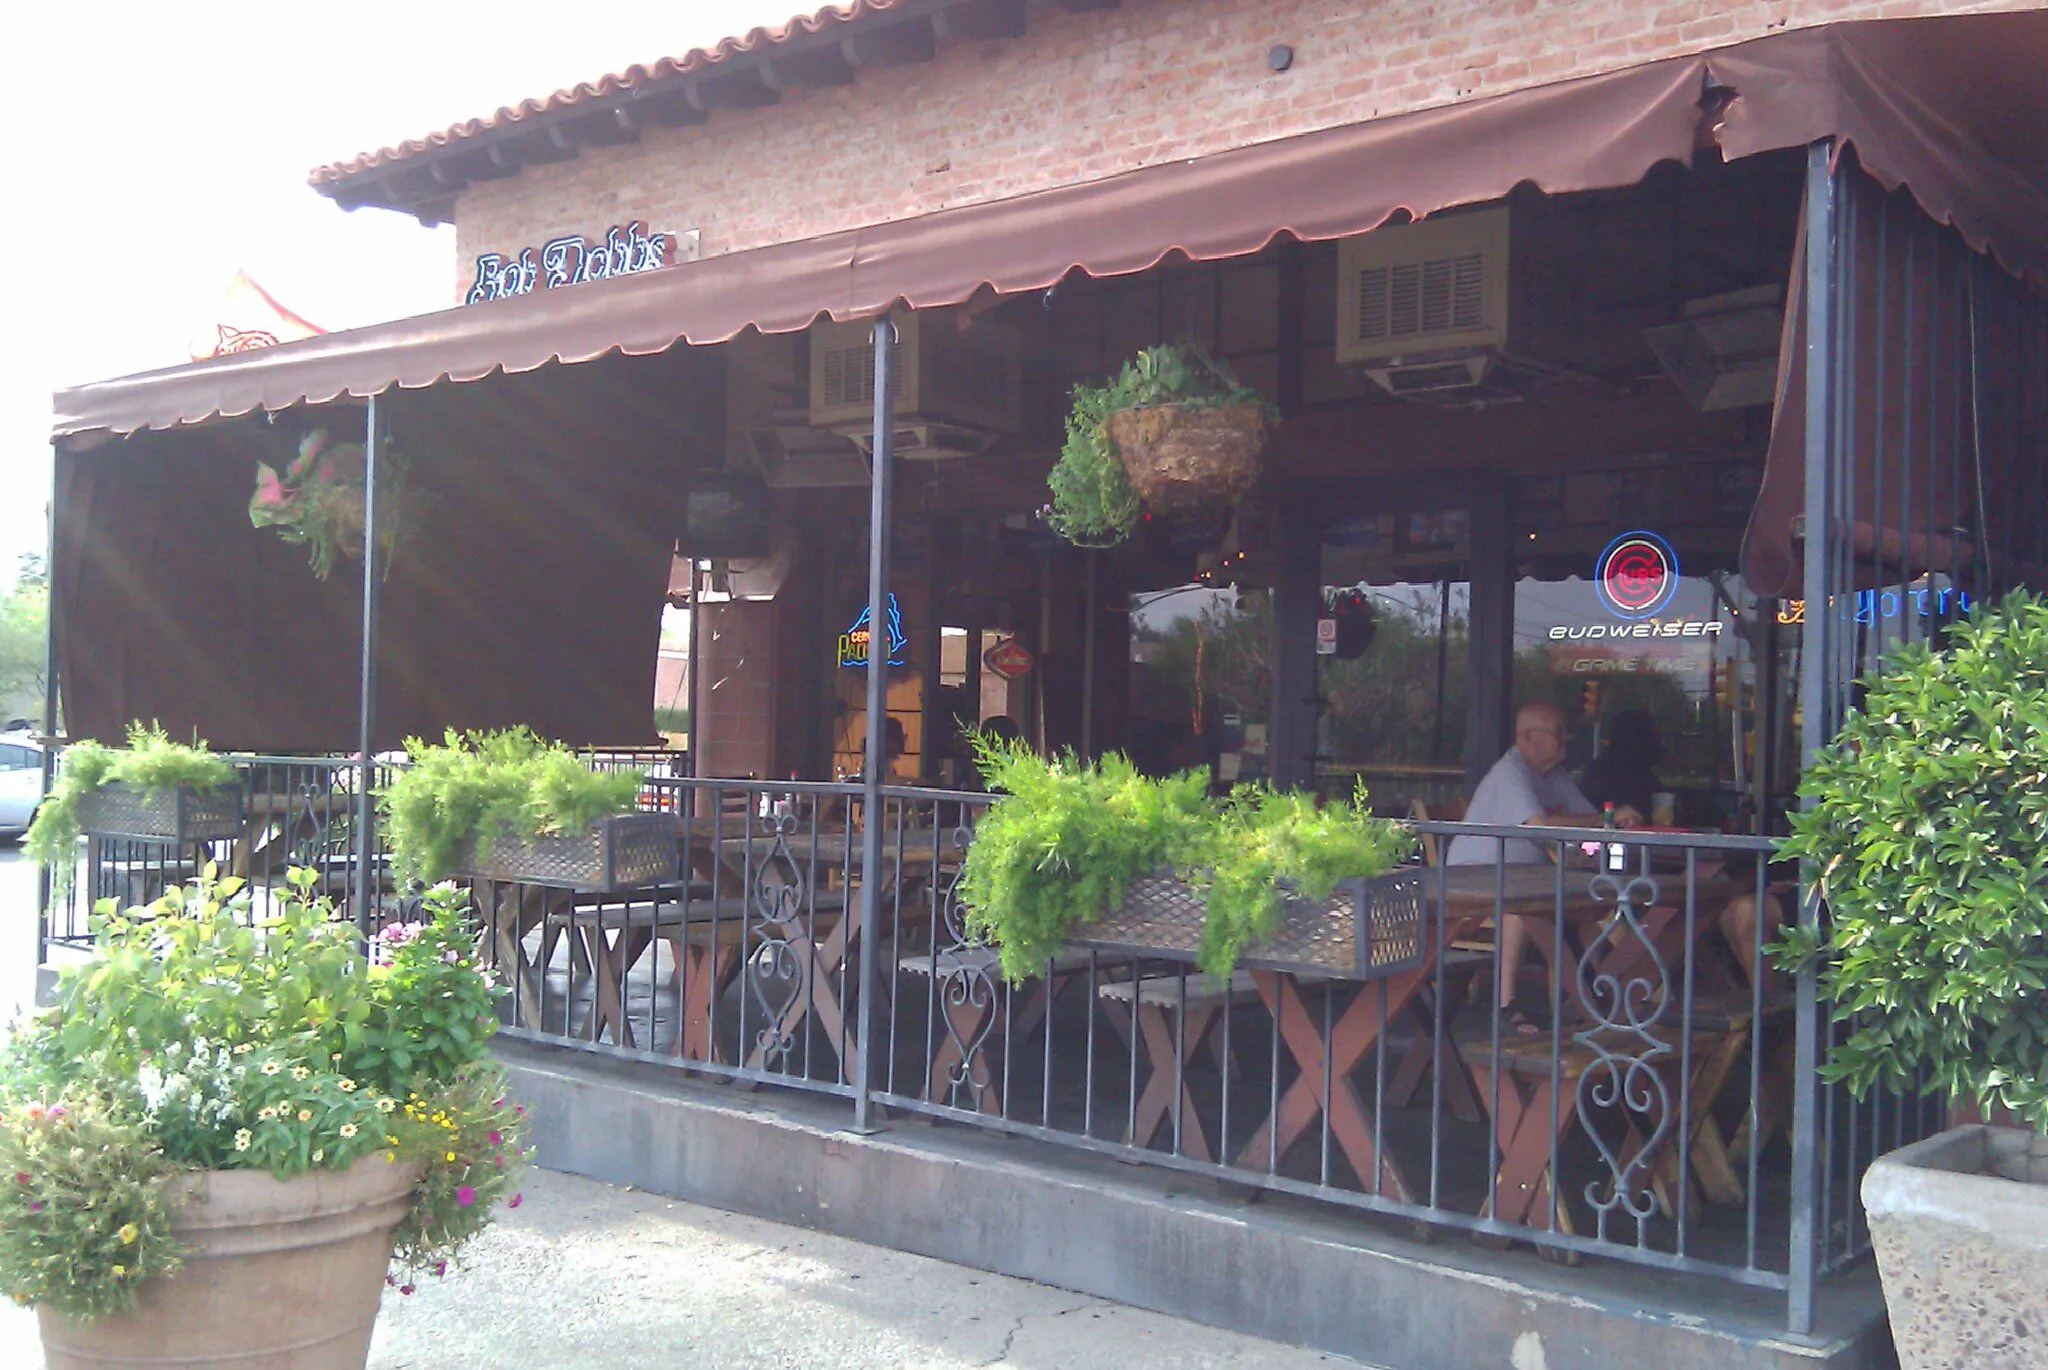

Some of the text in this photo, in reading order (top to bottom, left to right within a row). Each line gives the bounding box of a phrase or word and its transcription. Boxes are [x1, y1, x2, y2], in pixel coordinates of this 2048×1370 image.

[465, 247, 537, 305] Bob
[1549, 621, 1723, 640] BUDWEISER
[1573, 658, 1640, 672] GAME
